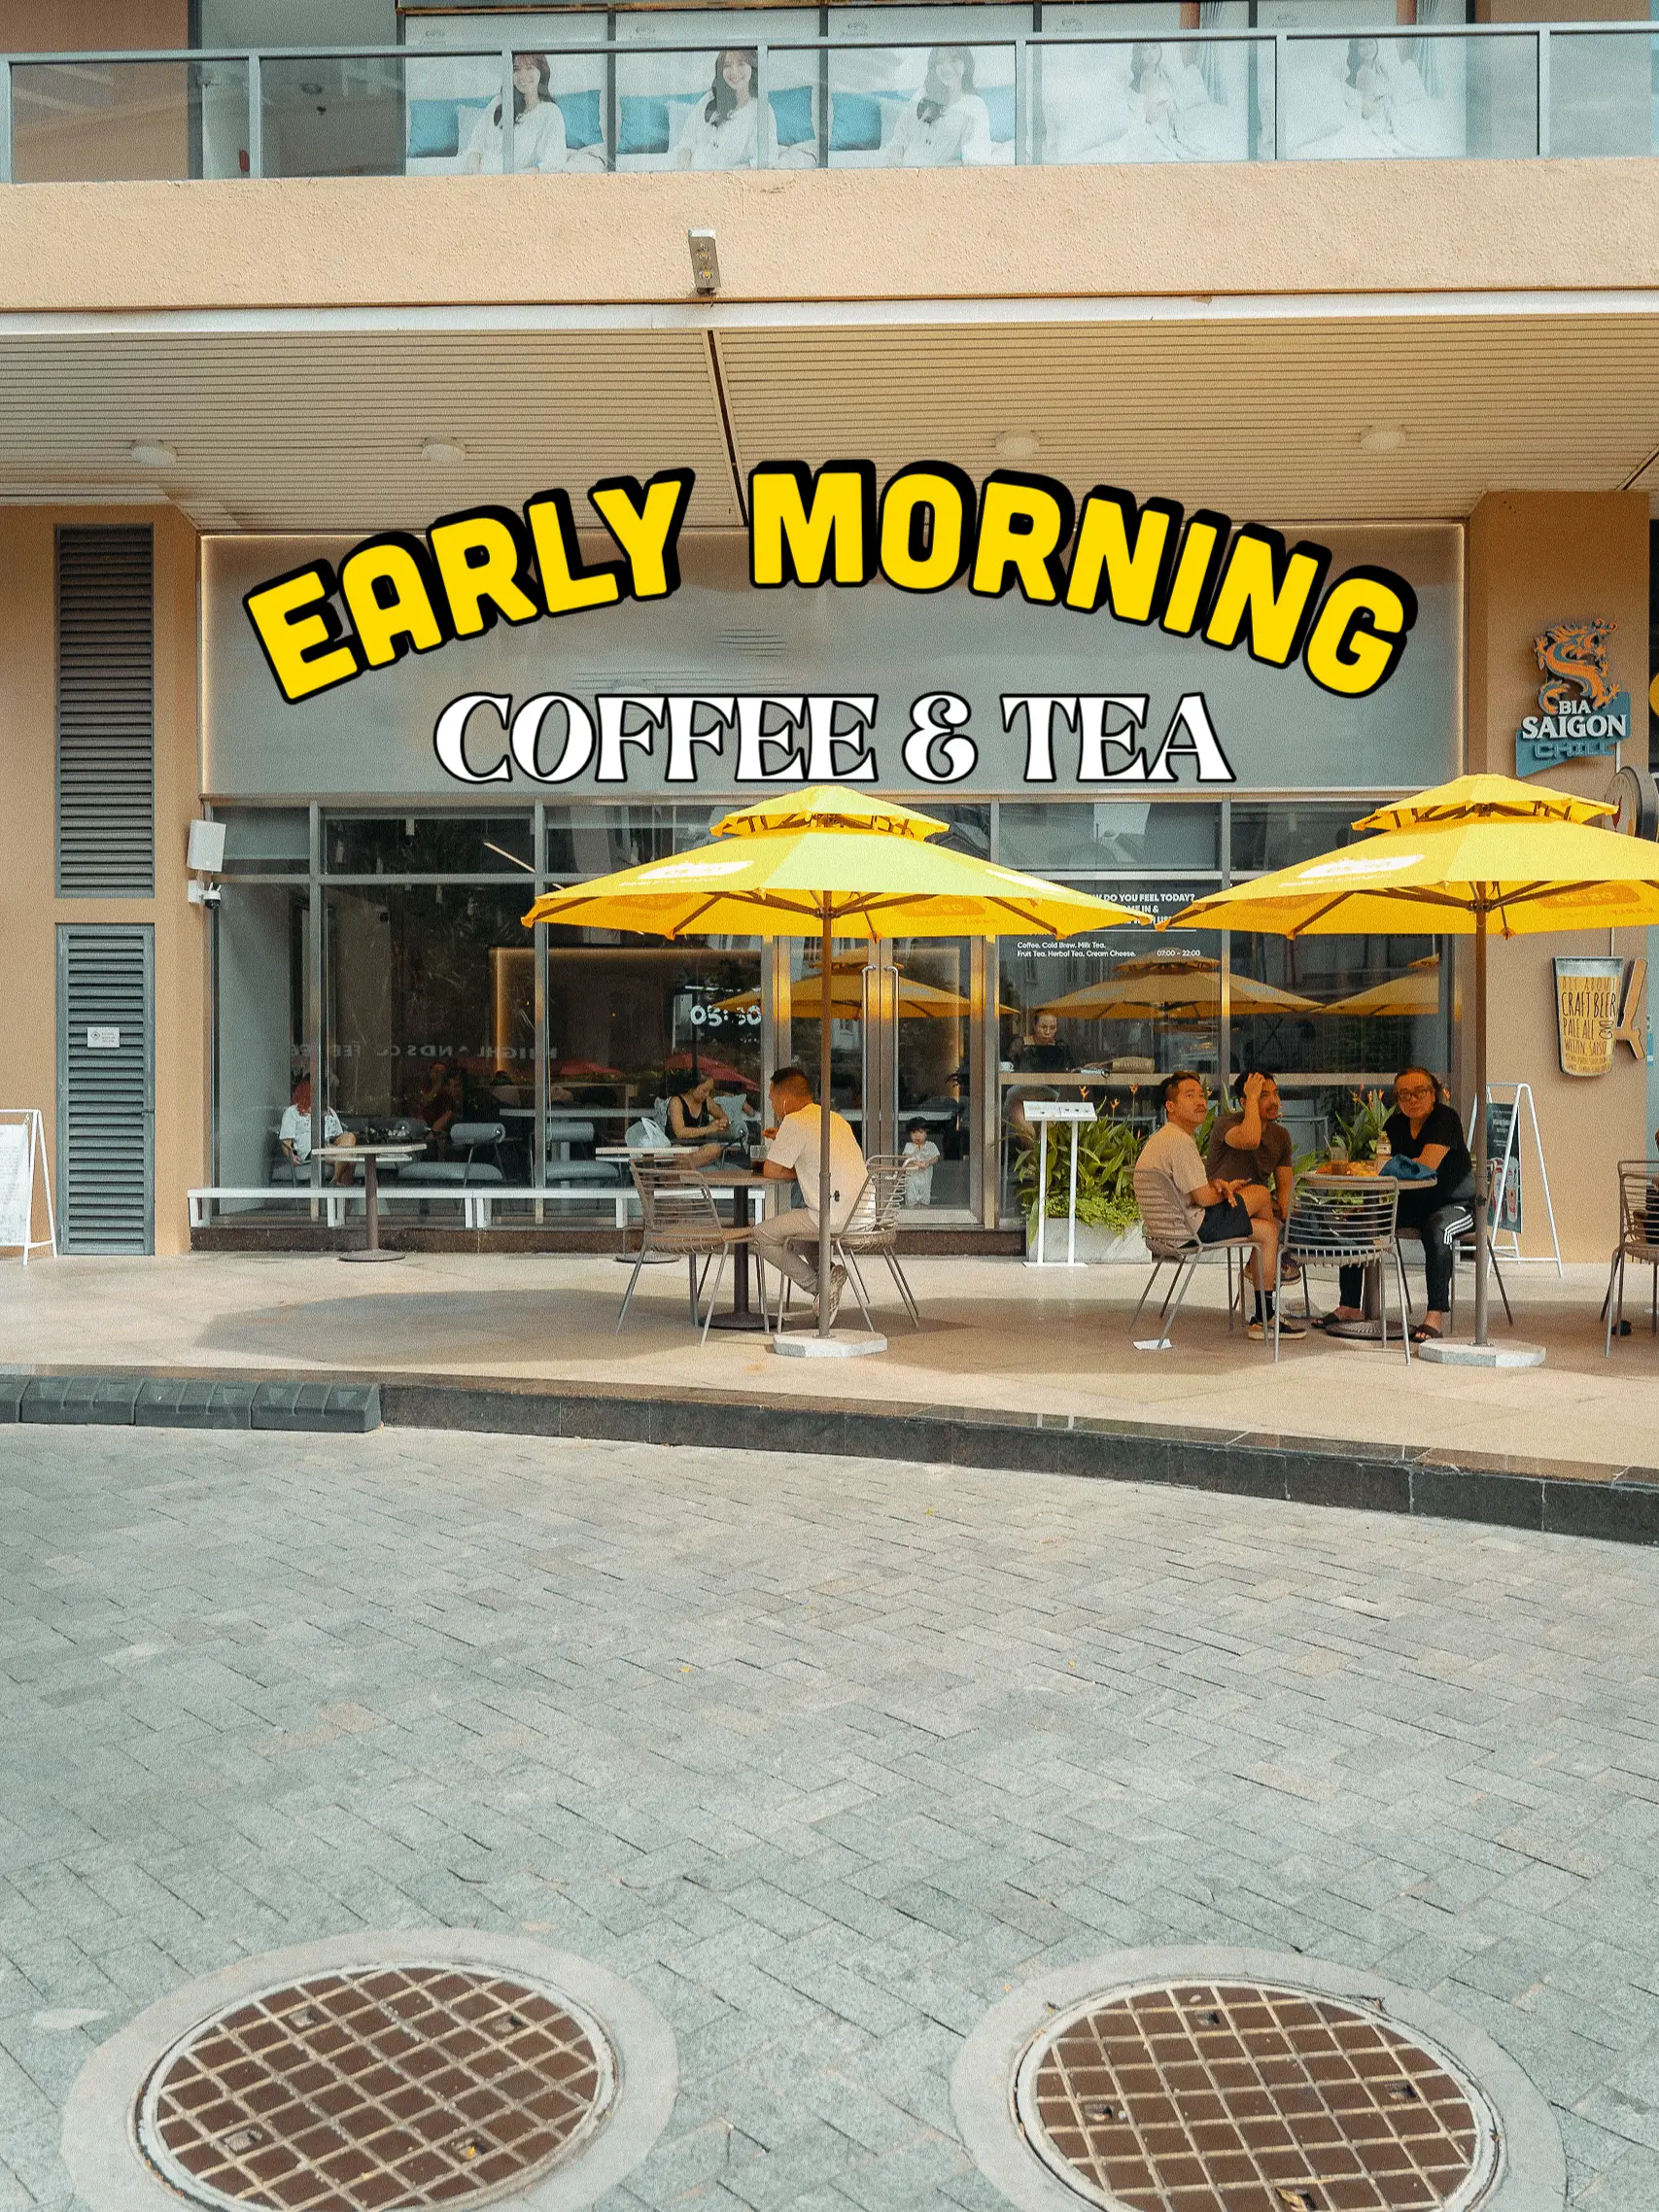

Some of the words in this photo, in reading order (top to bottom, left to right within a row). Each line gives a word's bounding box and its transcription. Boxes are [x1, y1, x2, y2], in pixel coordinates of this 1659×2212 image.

[1558, 700, 1592, 714] BIA
[1522, 714, 1627, 740] SAIGON
[1534, 742, 1616, 760] CHILL
[1104, 893, 1118, 902] DO
[1119, 893, 1138, 902] YOU
[1139, 893, 1159, 902] FEEL
[1160, 893, 1195, 902] TODAY?
[1561, 991, 1591, 1018] CRAFT
[1593, 991, 1616, 1019] BEER
[1563, 1018, 1580, 1038] PALE
[1581, 1020, 1595, 1041] ALE
